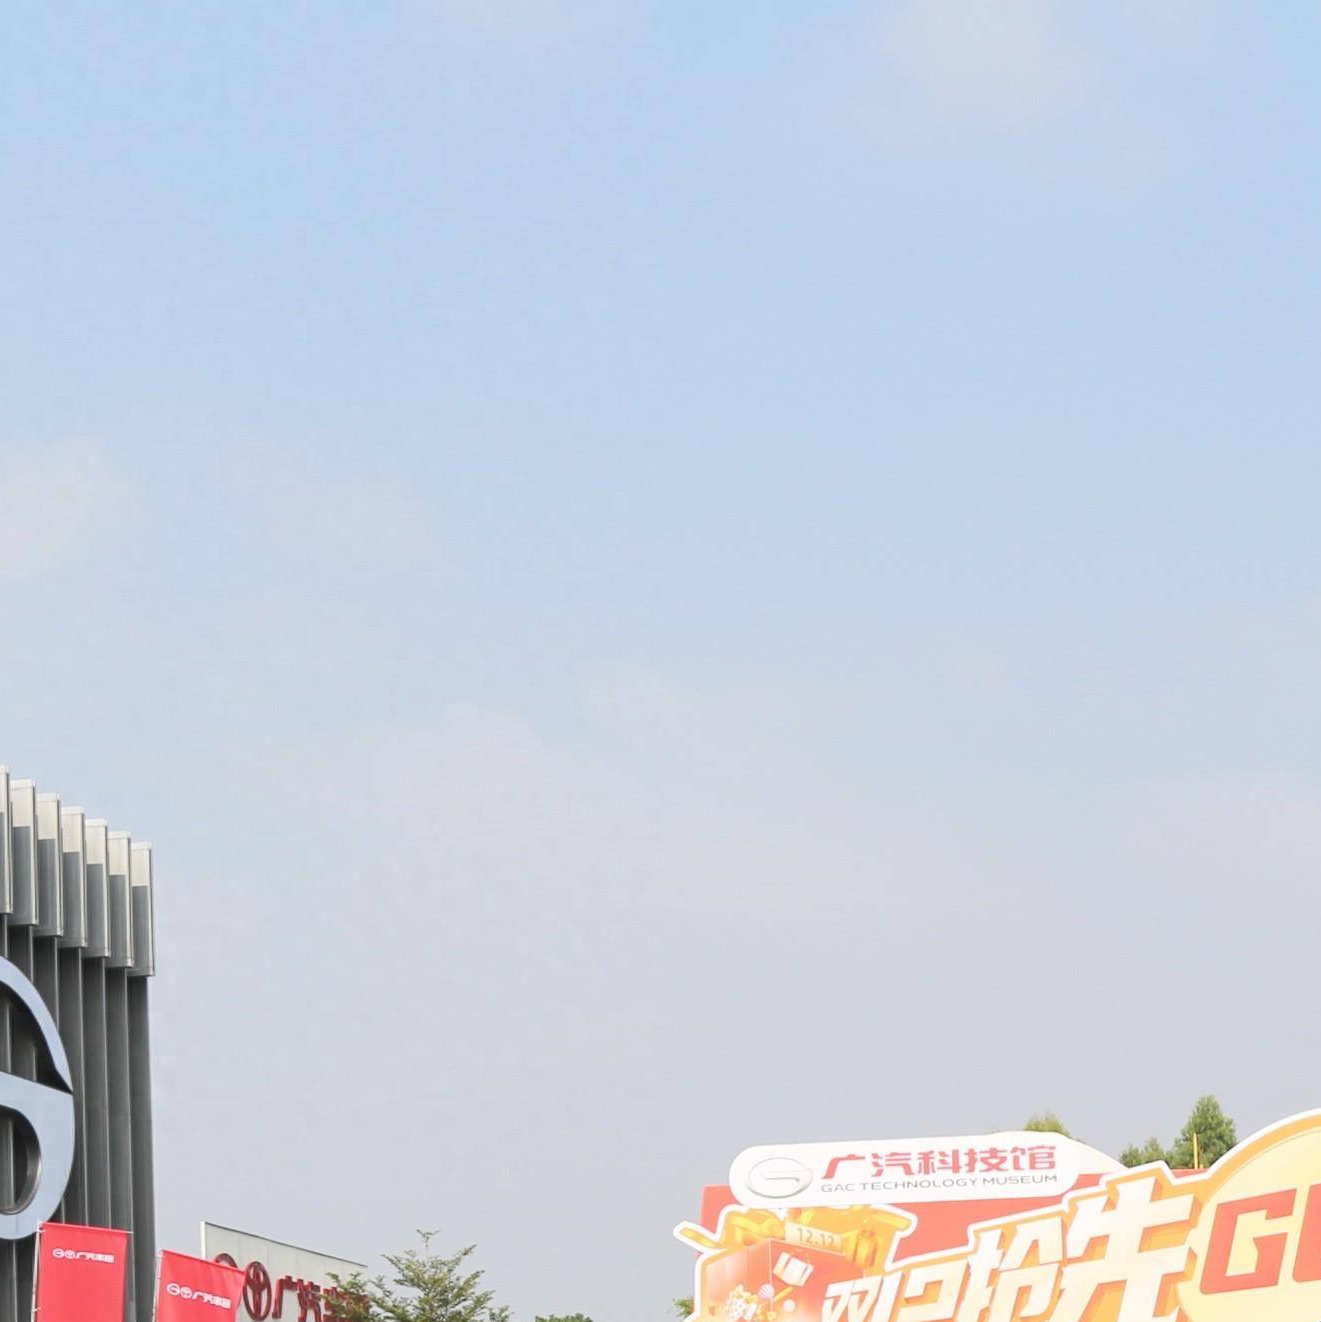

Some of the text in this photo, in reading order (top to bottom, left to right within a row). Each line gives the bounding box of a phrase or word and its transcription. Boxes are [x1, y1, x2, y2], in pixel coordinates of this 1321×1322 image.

[821, 1145, 1057, 1180] 广汽科技馆
[821, 1174, 1058, 1193] GAC TECHNOLOGY MUSEUM
[797, 1227, 836, 1249] 12.12
